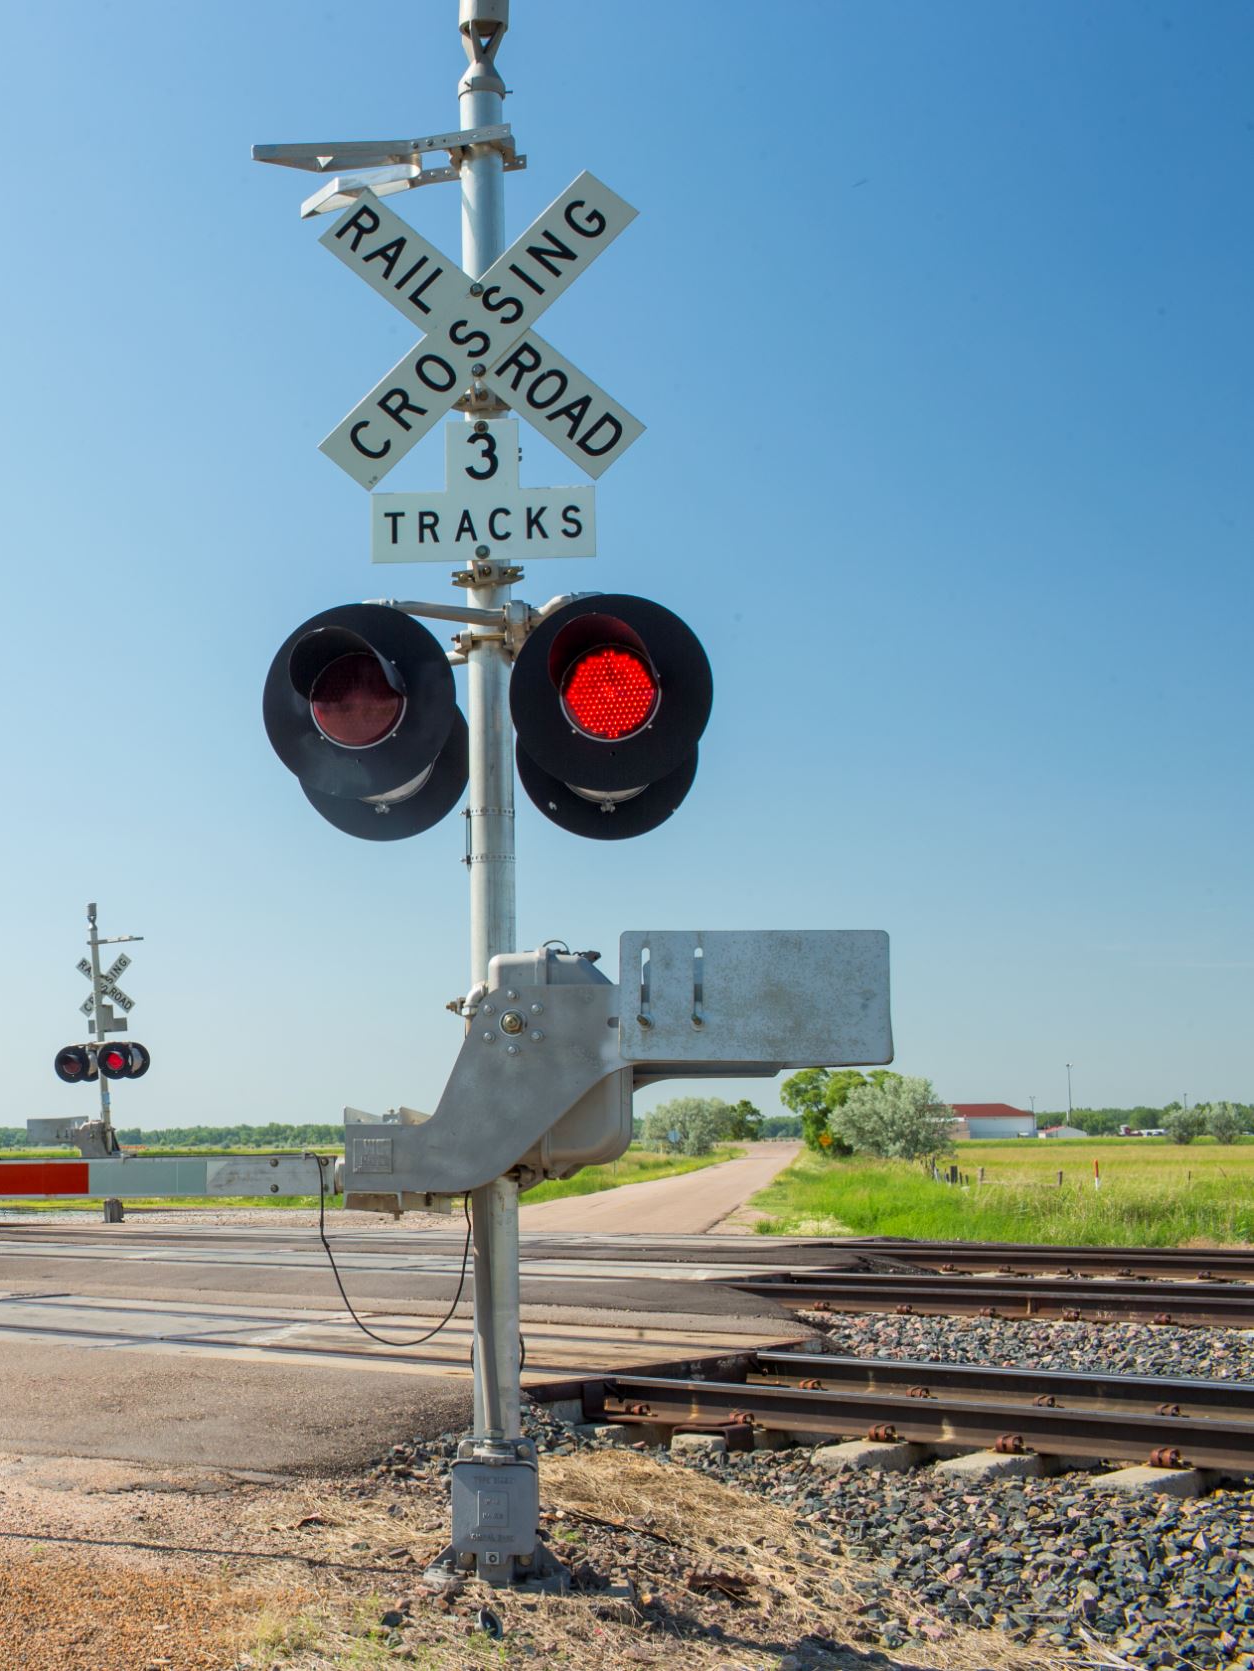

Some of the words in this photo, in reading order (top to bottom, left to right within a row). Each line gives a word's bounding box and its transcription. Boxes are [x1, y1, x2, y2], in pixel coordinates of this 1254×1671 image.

[334, 205, 445, 315] RAIL
[494, 341, 624, 458] ROAD
[349, 198, 607, 460] CROSSING
[464, 432, 499, 481] 3
[383, 504, 584, 545] TRACKS
[109, 987, 132, 1010] ROAD
